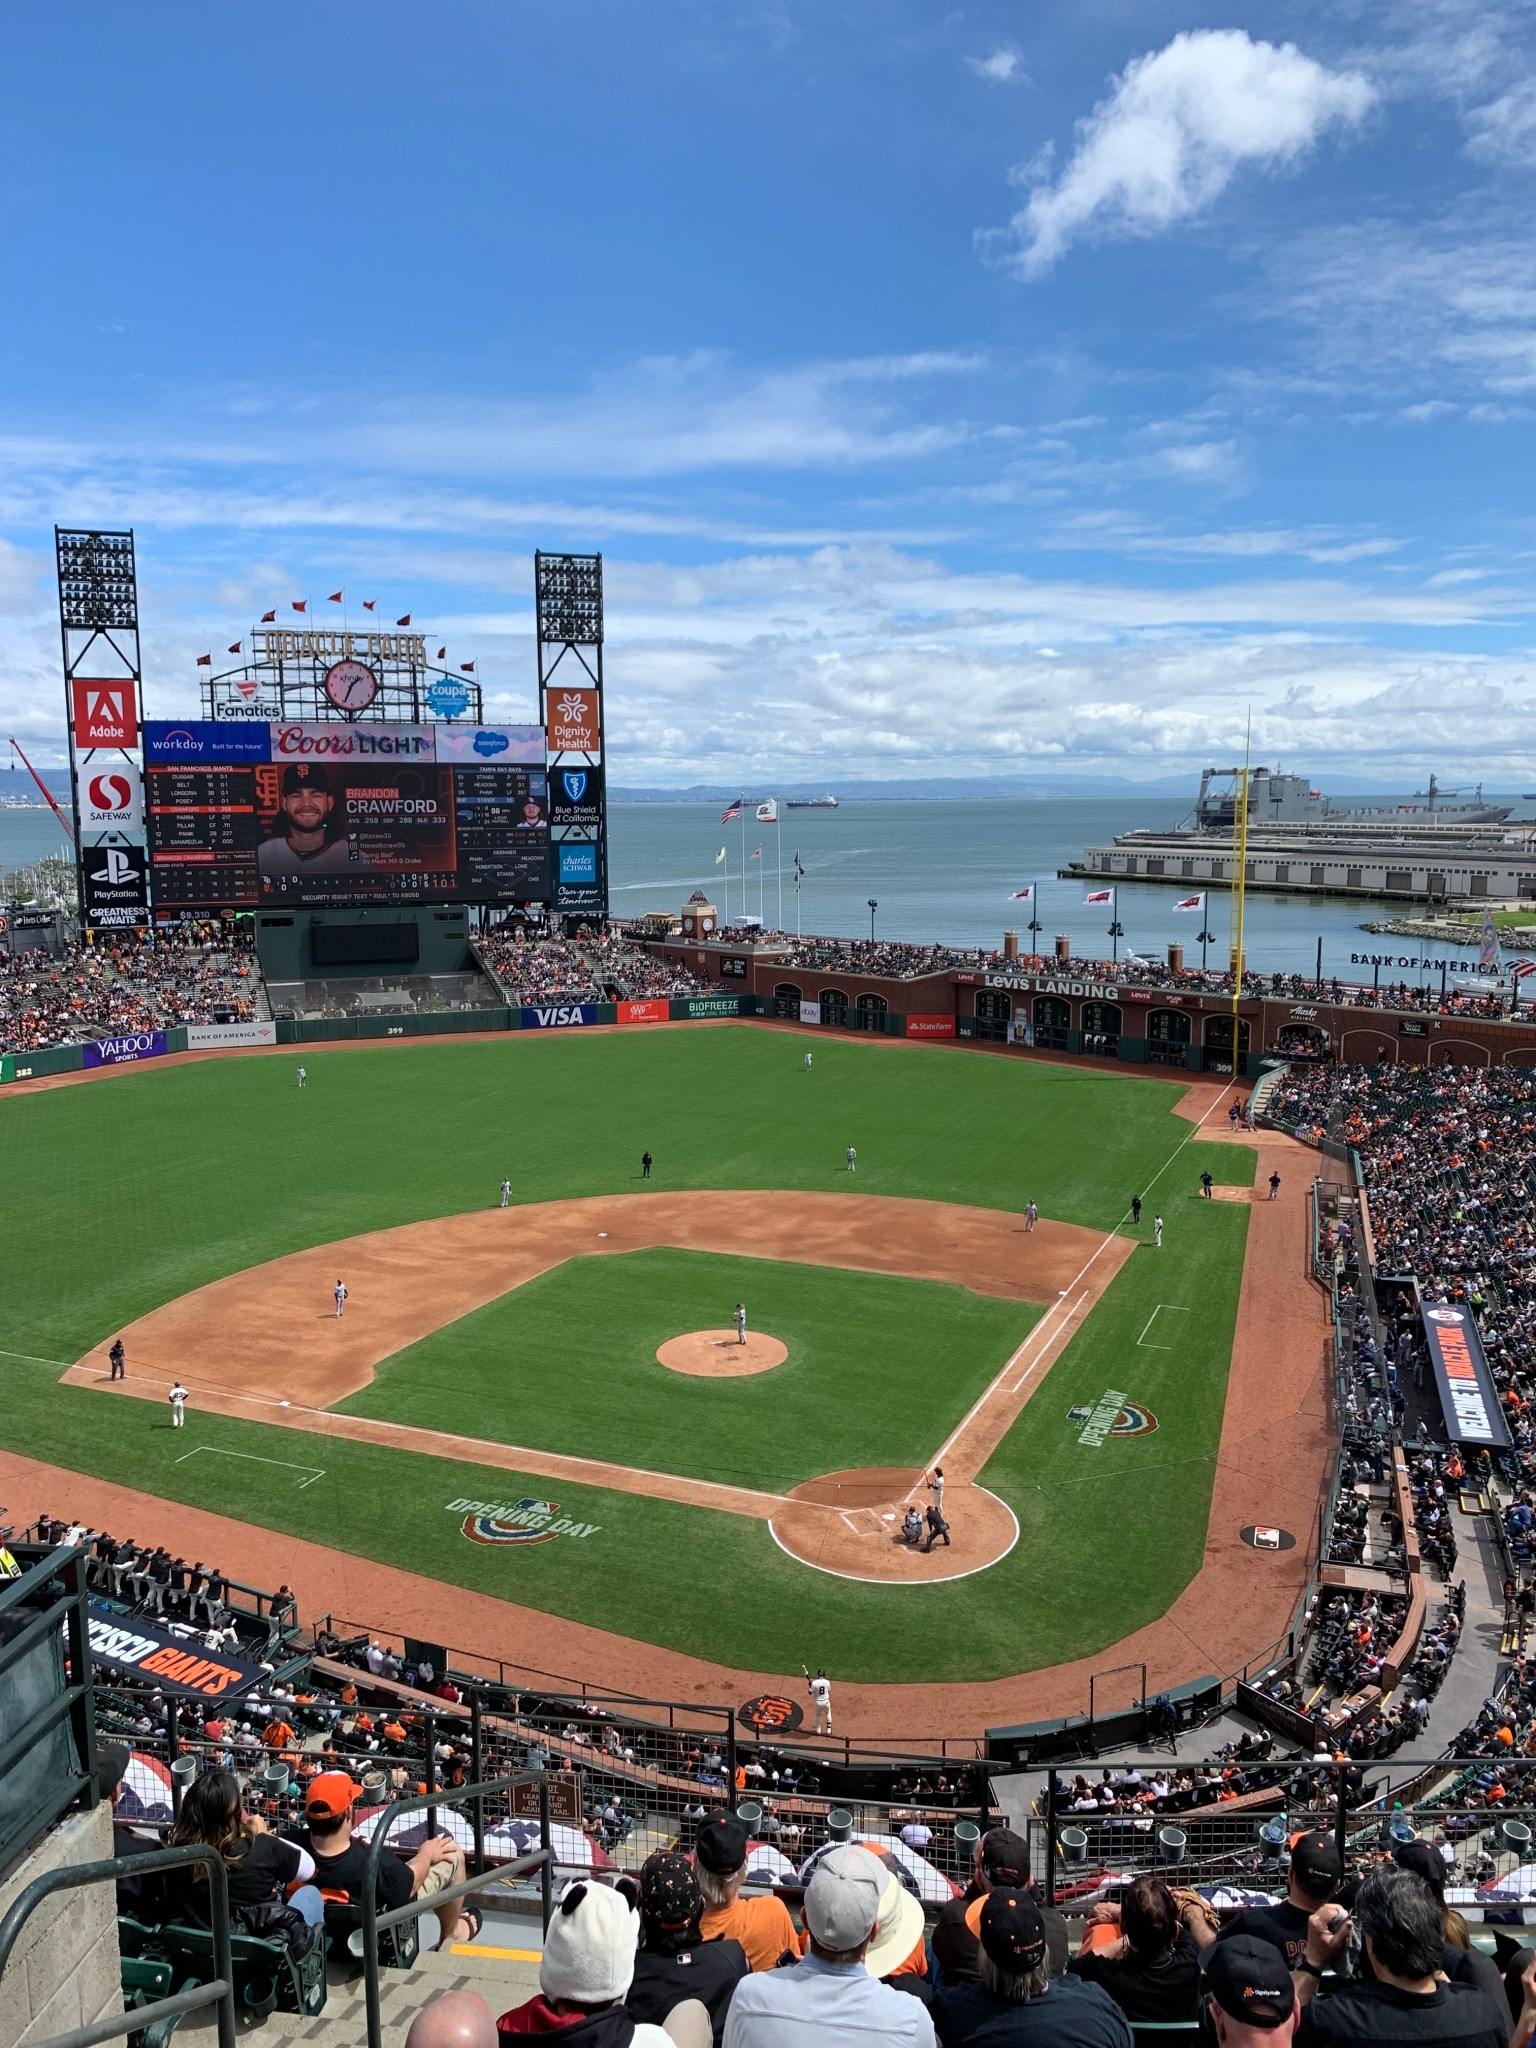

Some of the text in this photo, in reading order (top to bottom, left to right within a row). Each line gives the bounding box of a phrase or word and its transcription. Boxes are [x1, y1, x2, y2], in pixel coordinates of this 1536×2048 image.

[265, 630, 428, 667] ORACLE PARK
[432, 685, 466, 698] coupa
[216, 702, 279, 717] Fanatics
[89, 726, 124, 738] Adobe
[554, 725, 591, 738] Dignity
[152, 739, 204, 751] workday
[277, 727, 423, 754] Coors LIGHT
[477, 739, 506, 748] salesforce
[557, 738, 591, 749] Health
[347, 789, 398, 798] BRANDON
[346, 799, 437, 813] CRAWFORD
[555, 805, 597, 814] Blue Shield
[90, 812, 132, 821] SAFEWAY
[552, 814, 600, 823] of California
[562, 855, 592, 865] charles
[562, 864, 593, 872] SCHWAB
[94, 890, 138, 900] PlayStation
[558, 886, 599, 899] Own your
[558, 896, 600, 905] tomorrow
[89, 906, 144, 918] GREATNESS
[100, 915, 137, 925] AWAITS
[1351, 953, 1500, 975] BANK OF AMERICA
[1035, 979, 1119, 1000] LANDING
[532, 1007, 584, 1026] VISA
[801, 1007, 818, 1018] ebay
[1289, 1005, 1319, 1017] Alaska
[387, 1027, 403, 1035] 399
[1434, 1021, 1441, 1029] K
[222, 1031, 256, 1039] AMERICA
[959, 1028, 972, 1036] 365
[97, 1034, 153, 1059] YAHOO!
[114, 1052, 139, 1063] SPORTS
[16, 1067, 32, 1077] 382
[1216, 1064, 1232, 1073] 309
[1436, 1325, 1467, 1348] PARK
[1440, 1348, 1476, 1379] ORACLE
[1448, 1378, 1480, 1391] TO
[1077, 1388, 1128, 1447] OPENING DAY
[1451, 1390, 1493, 1439] WELCOME
[444, 1498, 603, 1538] OPENING DAY
[139, 1647, 243, 1695] GIANTS
[819, 1686, 825, 1695] 8
